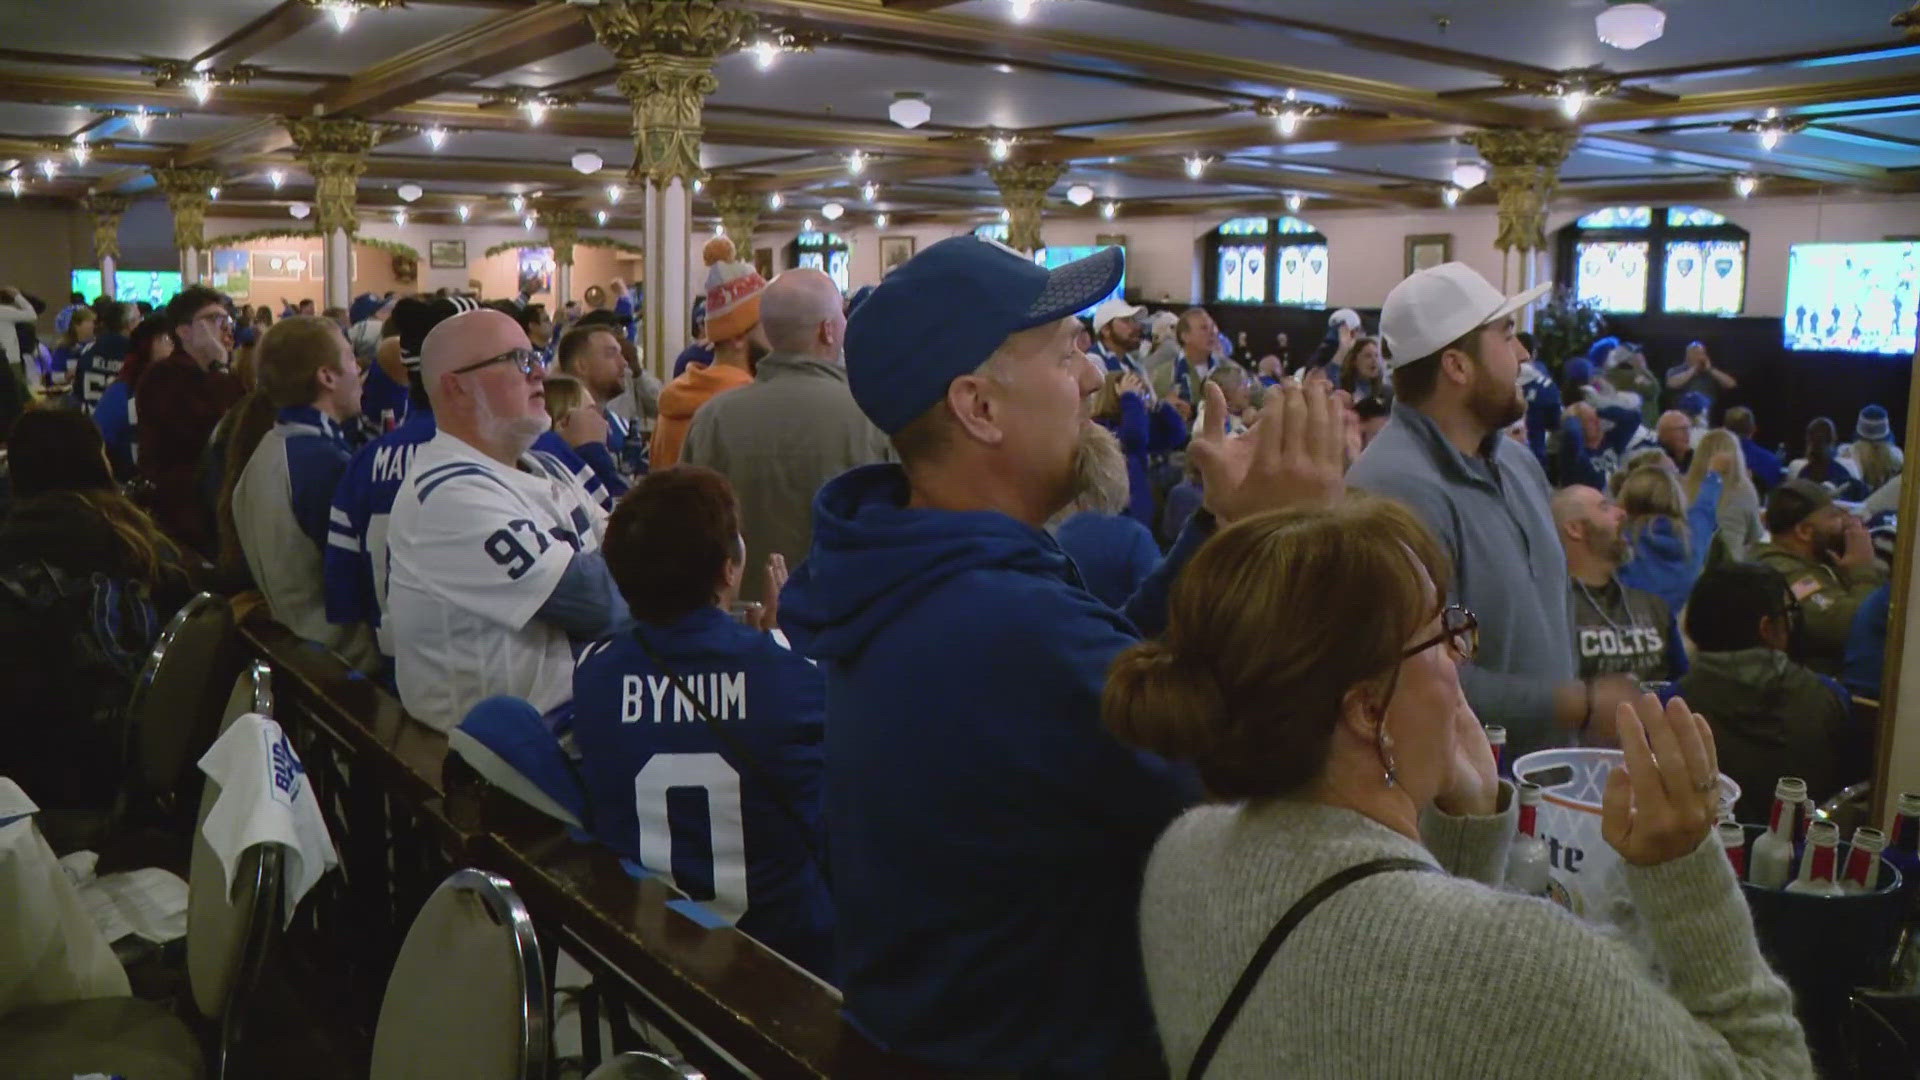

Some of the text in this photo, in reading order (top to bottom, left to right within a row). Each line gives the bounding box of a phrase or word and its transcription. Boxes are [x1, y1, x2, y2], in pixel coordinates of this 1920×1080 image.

[1581, 627, 1663, 657] COLTS
[621, 671, 746, 723] BYNUM
[635, 752, 748, 927] 0
